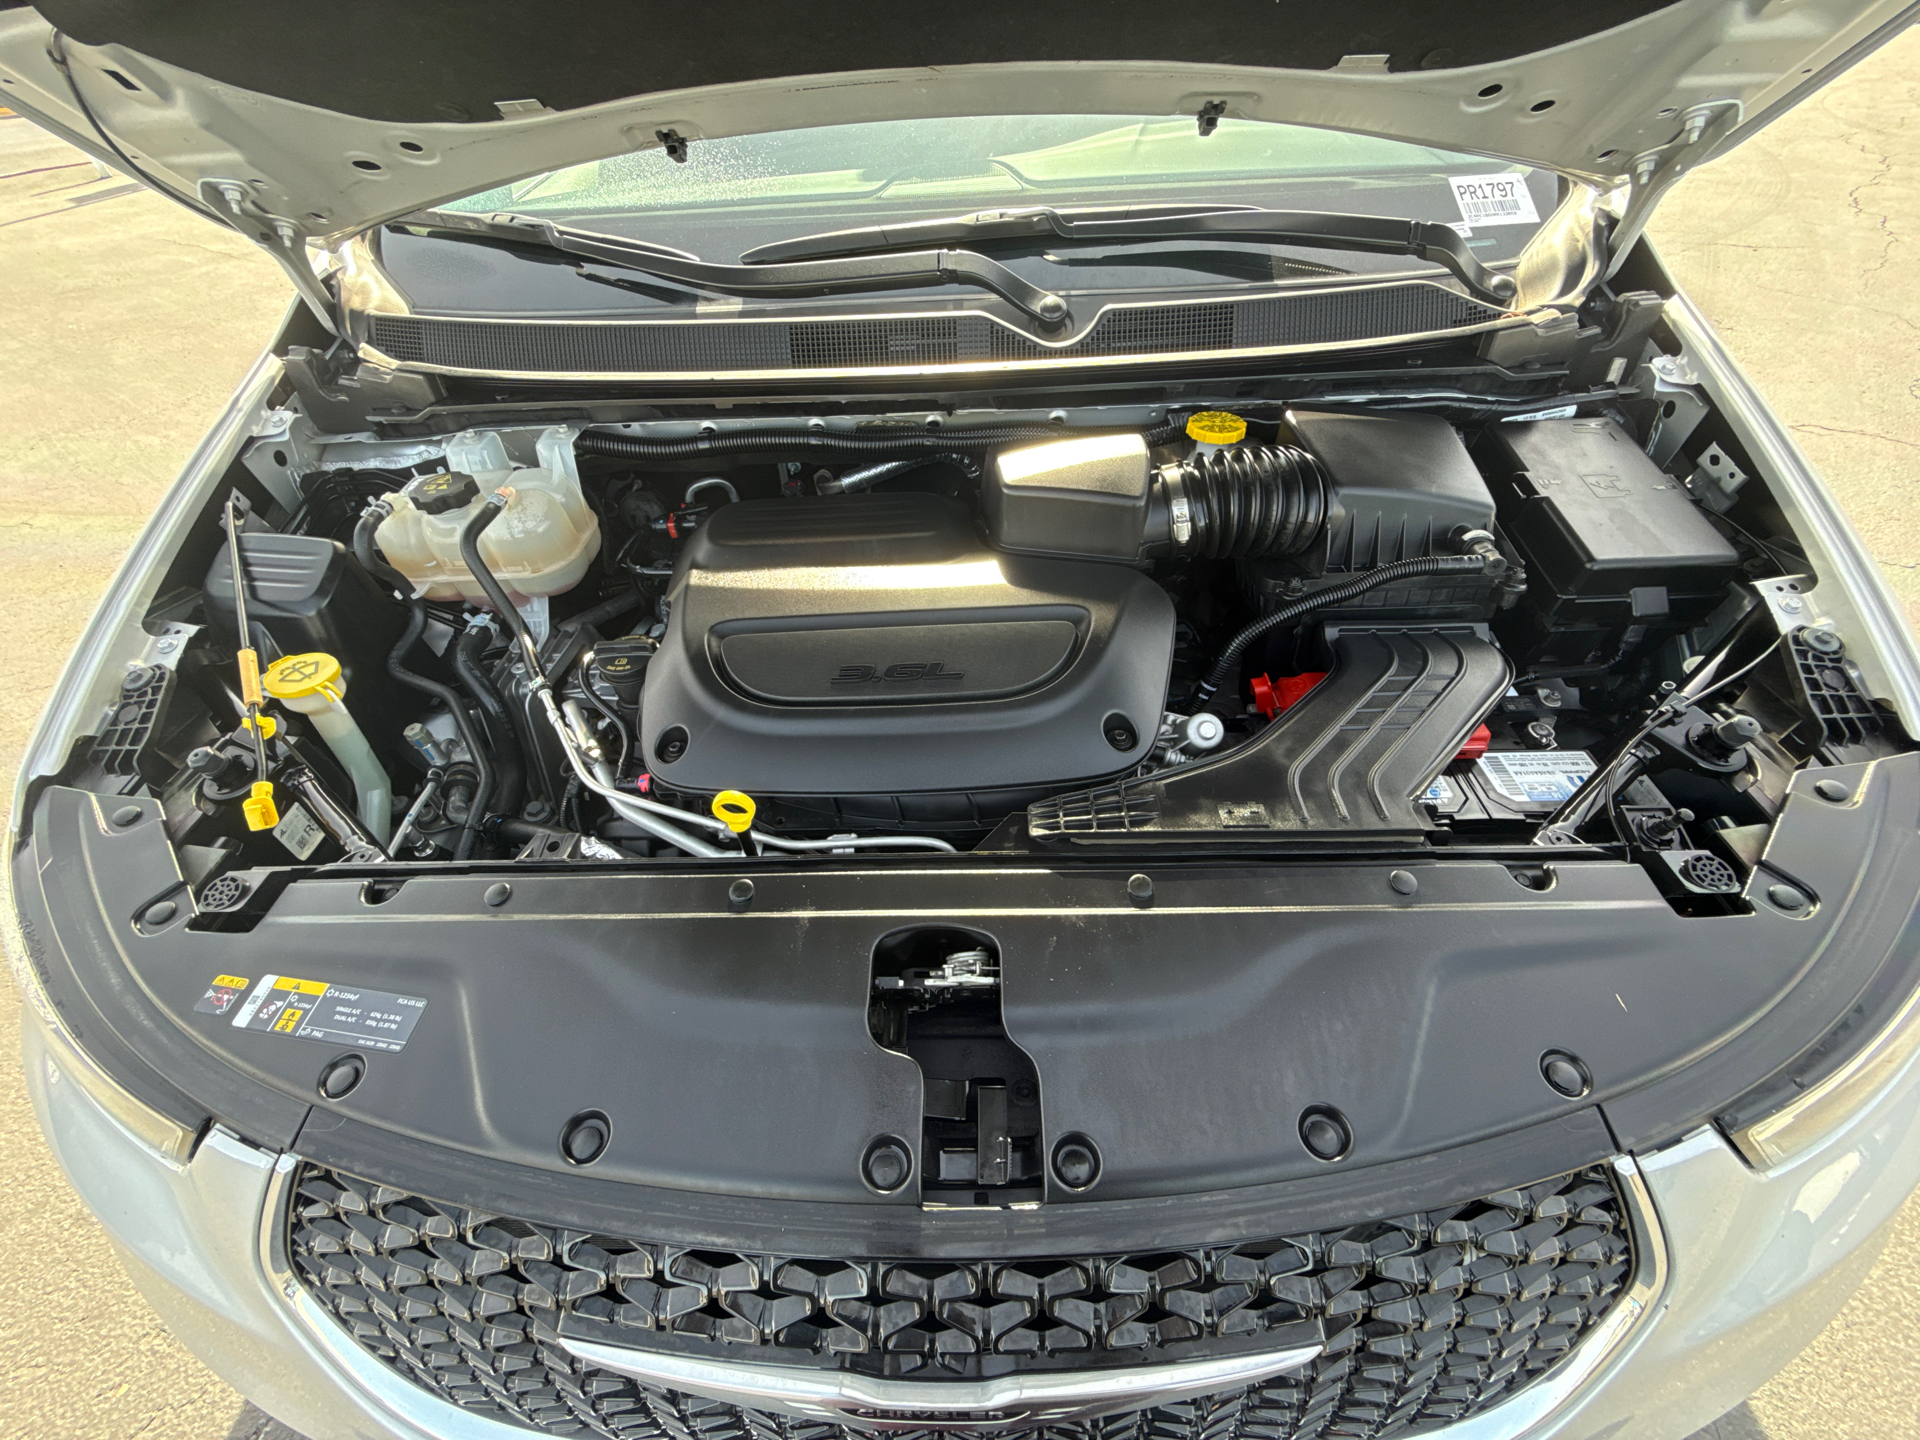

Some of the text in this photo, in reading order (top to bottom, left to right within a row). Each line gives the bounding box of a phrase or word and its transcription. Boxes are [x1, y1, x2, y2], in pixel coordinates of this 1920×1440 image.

[1456, 181, 1515, 201] PR1797
[830, 661, 965, 684] 3.6L
[303, 824, 316, 838] R
[397, 997, 408, 1005] FCA
[311, 1030, 324, 1038] PAG
[857, 1408, 1006, 1421] CHRYSLER
